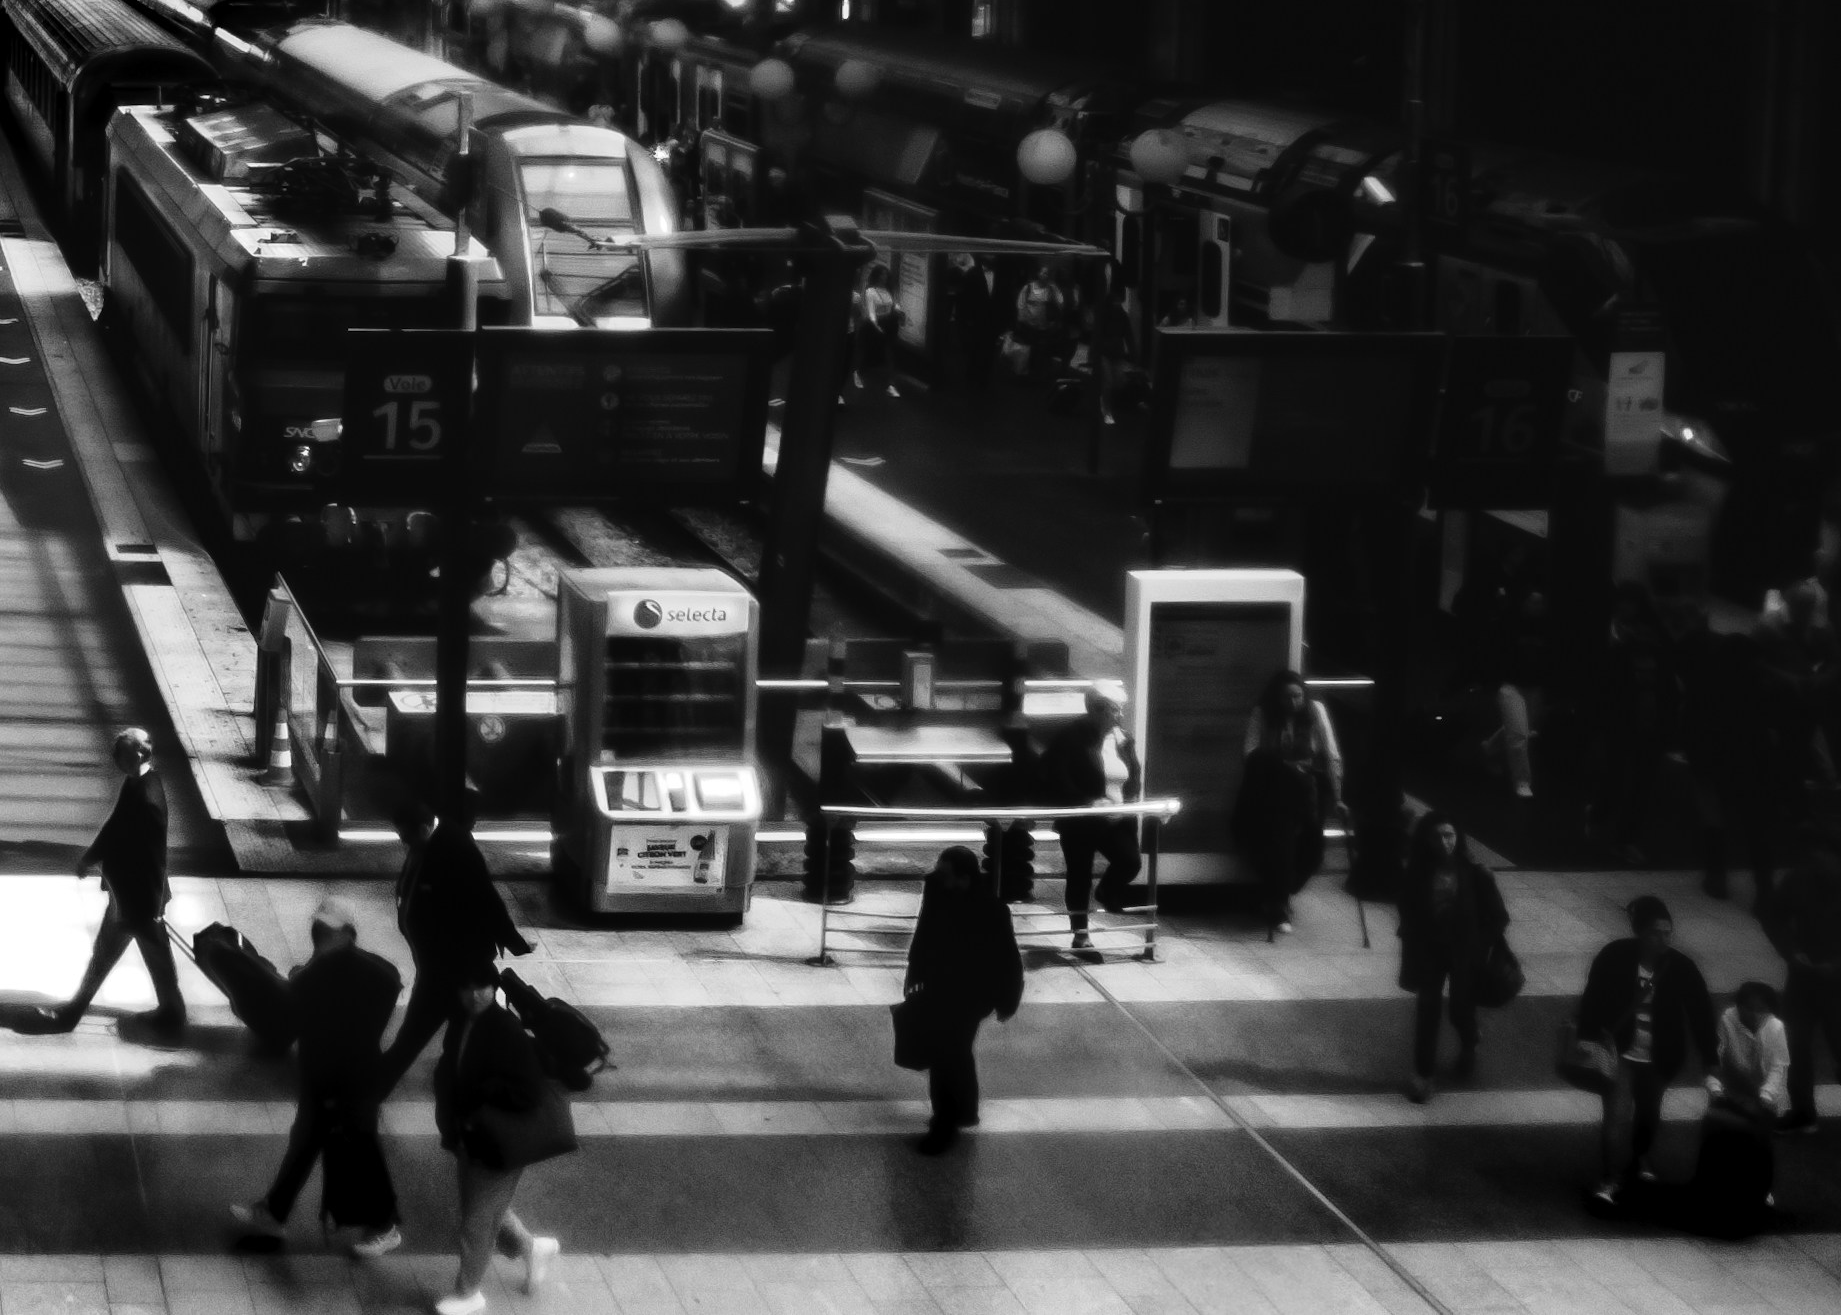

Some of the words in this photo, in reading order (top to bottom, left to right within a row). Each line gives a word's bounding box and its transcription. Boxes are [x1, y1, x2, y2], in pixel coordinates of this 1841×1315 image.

[1429, 173, 1459, 217] 16
[389, 377, 427, 391] Voie
[283, 426, 315, 438] SNC
[372, 399, 442, 451] 15
[1469, 402, 1537, 455] 16
[666, 606, 727, 623] selecta
